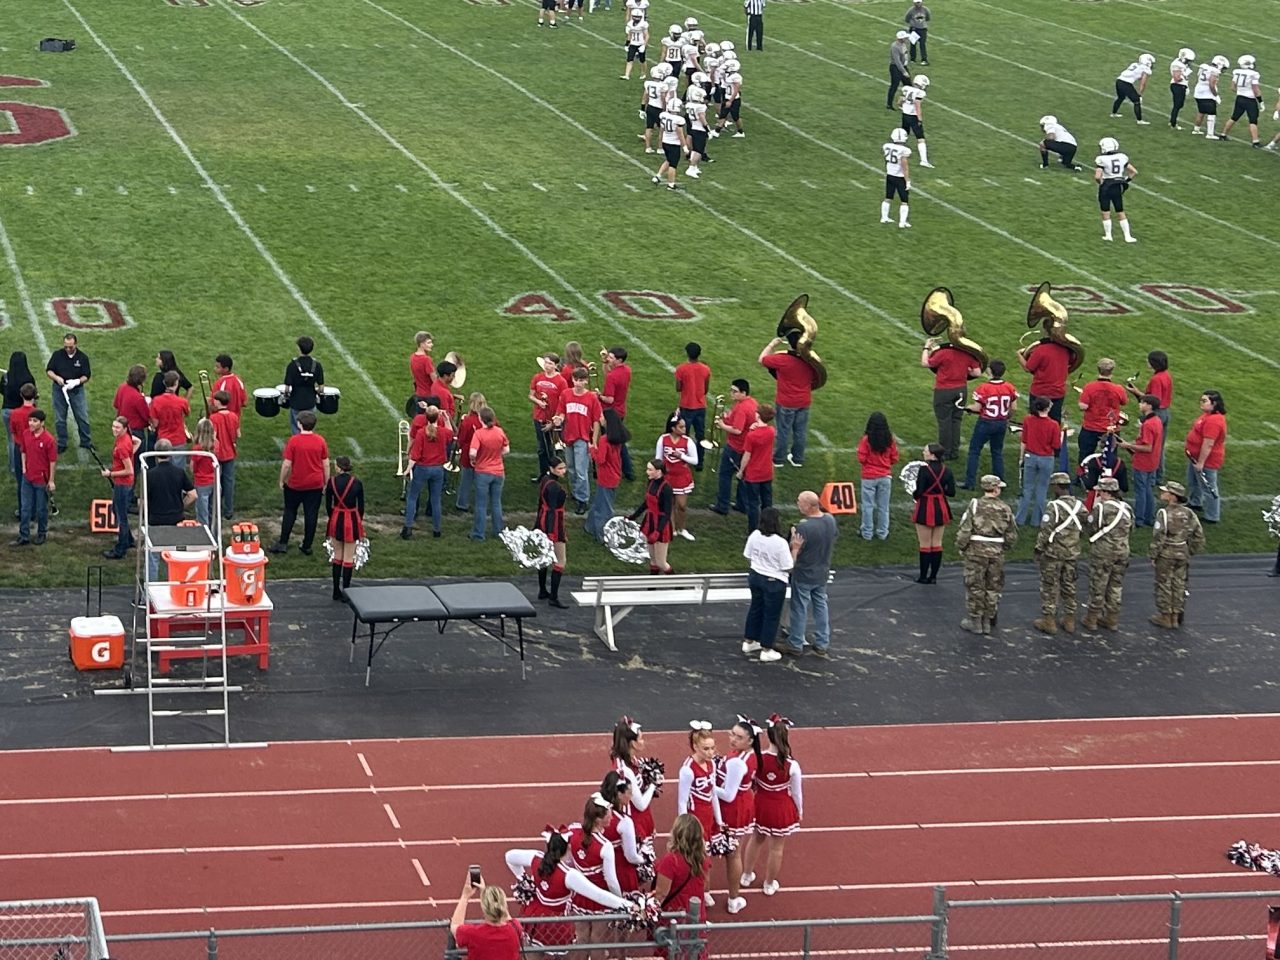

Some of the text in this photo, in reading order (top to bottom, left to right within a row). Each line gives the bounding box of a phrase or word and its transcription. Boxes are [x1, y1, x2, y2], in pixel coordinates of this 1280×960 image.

[668, 48, 679, 59] 81
[1234, 73, 1248, 87] 77
[885, 146, 899, 165] 26
[1111, 159, 1121, 174] 6
[985, 395, 1011, 417] 50
[830, 484, 855, 510] 40
[94, 502, 118, 529] 50
[243, 543, 251, 552] G
[243, 570, 255, 583] G
[91, 641, 111, 663] G
